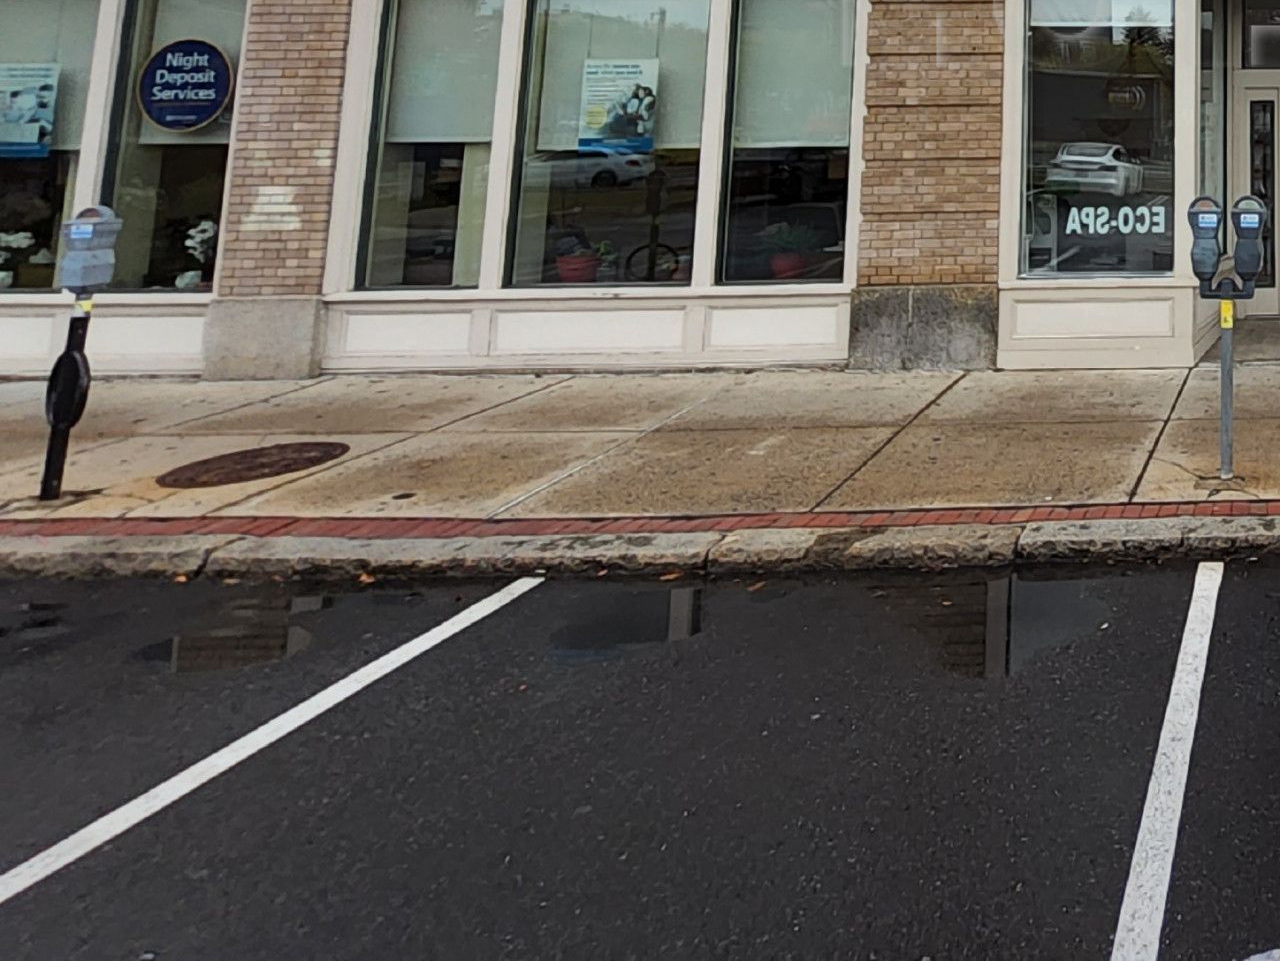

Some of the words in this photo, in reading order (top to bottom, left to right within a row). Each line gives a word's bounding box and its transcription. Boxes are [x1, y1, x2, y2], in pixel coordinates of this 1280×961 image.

[165, 52, 209, 70] Night
[155, 69, 217, 86] Deposit
[152, 86, 217, 101] Services
